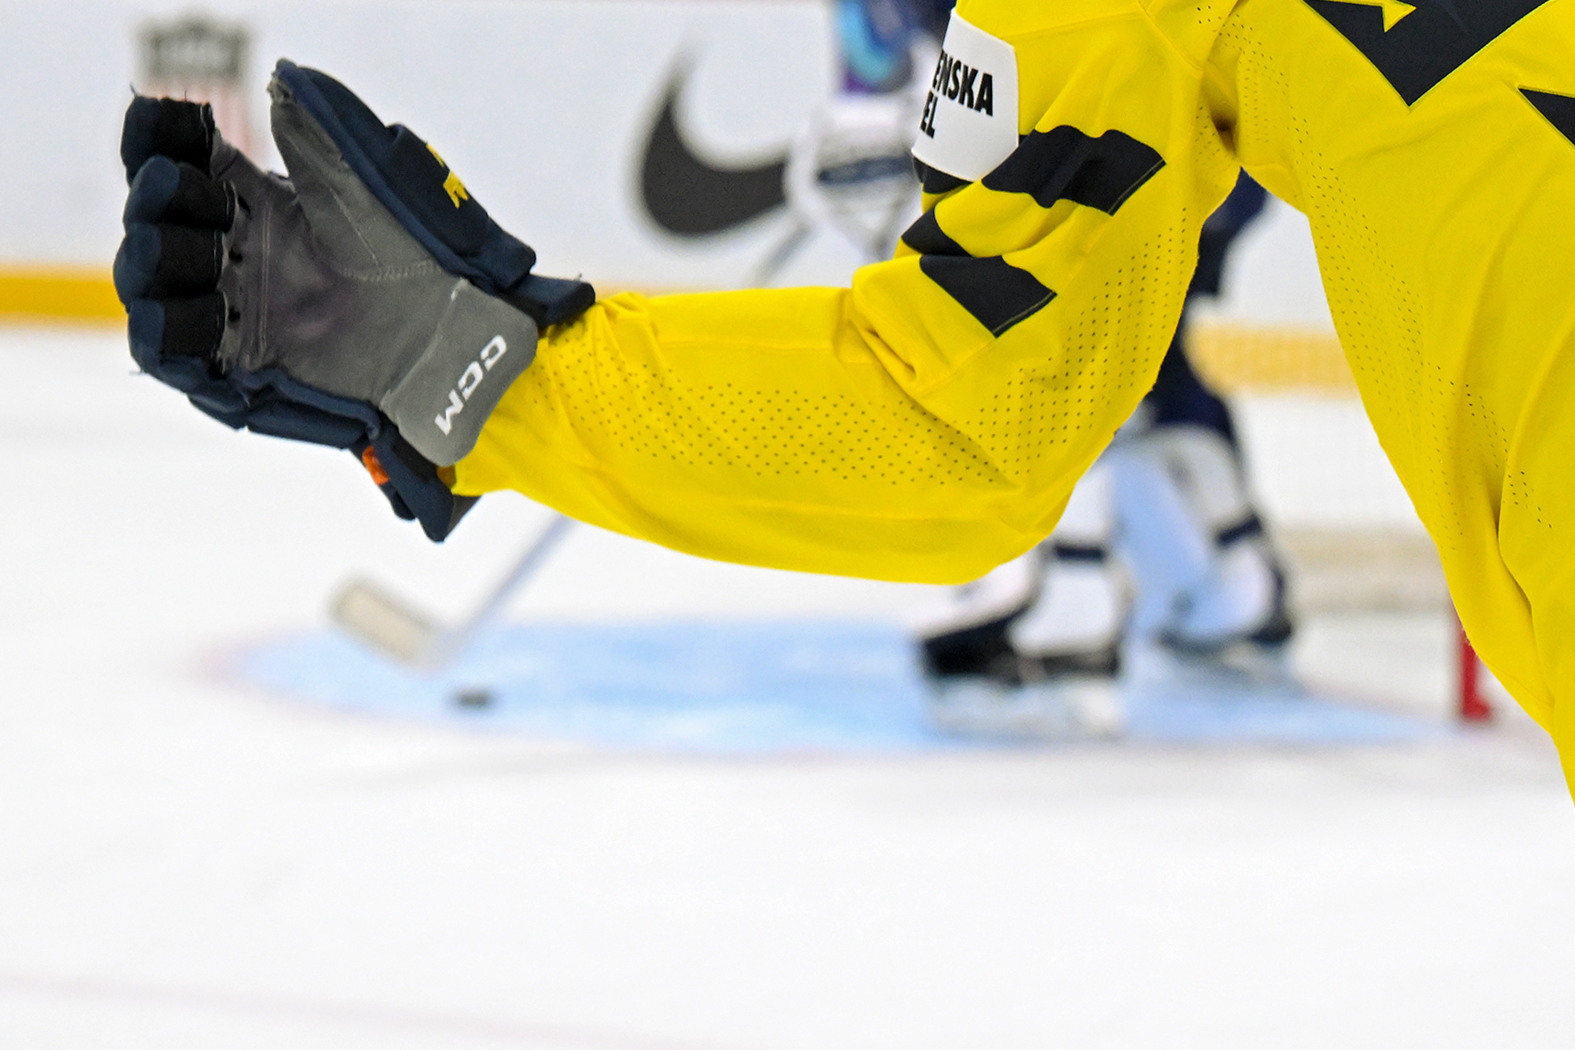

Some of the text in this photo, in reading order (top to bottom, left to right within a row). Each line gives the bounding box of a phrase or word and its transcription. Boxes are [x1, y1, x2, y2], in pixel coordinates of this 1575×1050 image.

[920, 90, 938, 139] EL
[932, 49, 993, 117] ENSKA
[434, 334, 507, 436] CCM
